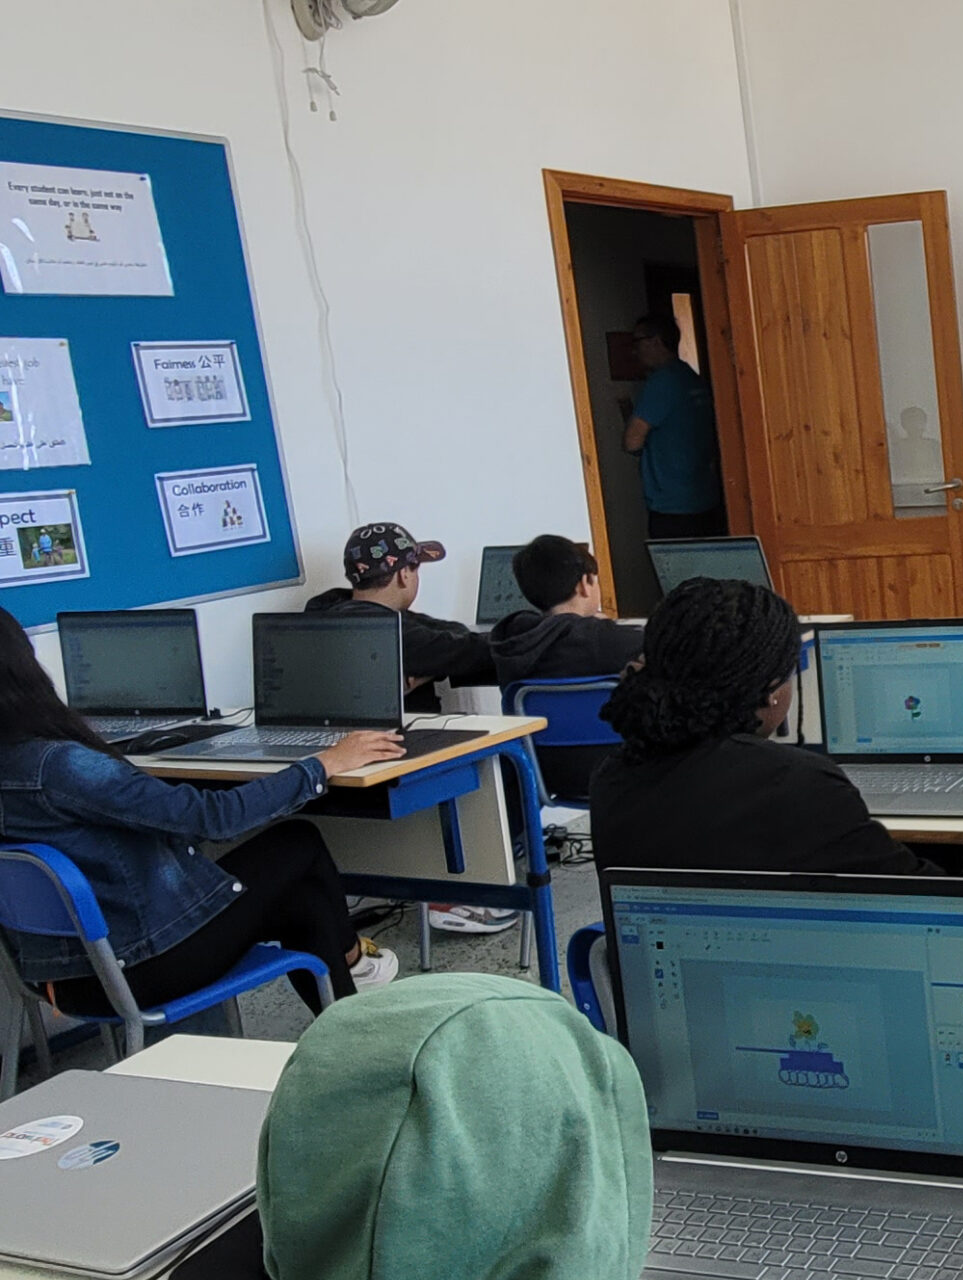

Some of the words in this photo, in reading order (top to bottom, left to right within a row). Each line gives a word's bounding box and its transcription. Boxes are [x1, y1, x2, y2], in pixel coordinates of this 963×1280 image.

[8, 181, 29, 193] Every
[30, 184, 56, 194] student
[153, 358, 196, 370] Fairness
[198, 354, 226, 369] 公平
[172, 479, 247, 497] Collaboration
[177, 502, 205, 518] 合作
